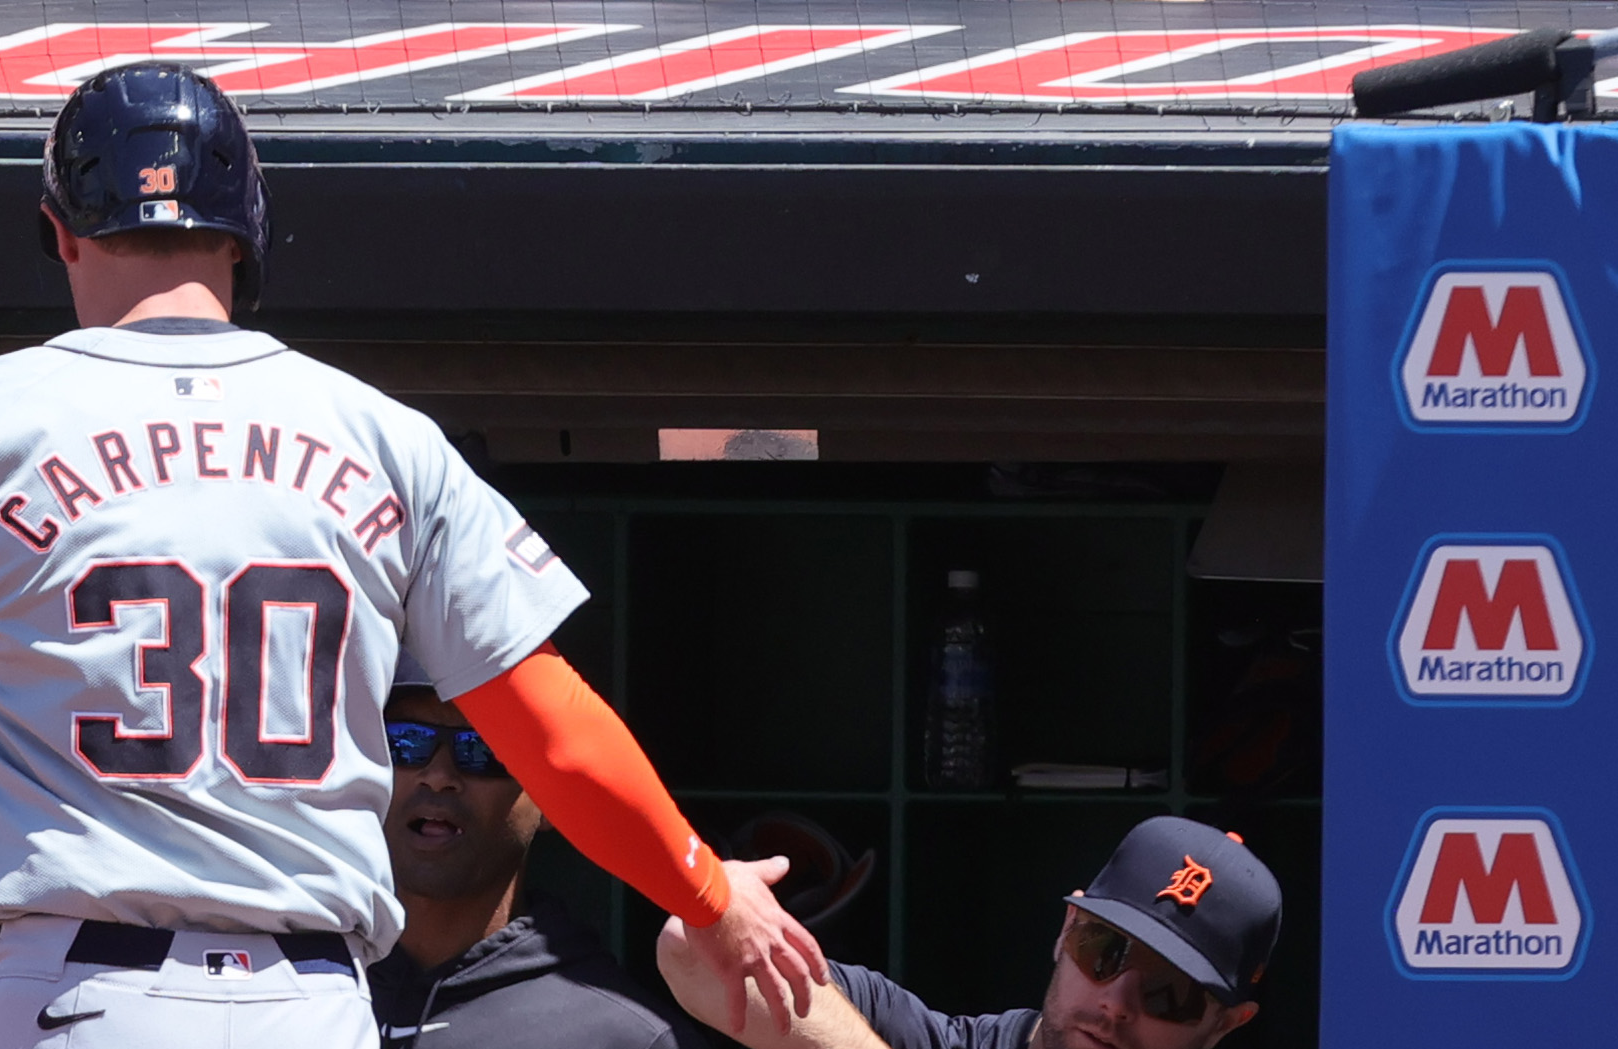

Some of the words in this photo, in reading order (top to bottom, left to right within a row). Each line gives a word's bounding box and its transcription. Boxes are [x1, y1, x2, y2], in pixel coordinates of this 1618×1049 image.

[139, 167, 175, 194] 30
[1427, 286, 1561, 377] M
[1421, 382, 1568, 409] Marathon
[1423, 559, 1558, 651] M
[65, 557, 354, 787] 30
[1418, 656, 1565, 682] Marathon
[1156, 854, 1213, 905] D
[1420, 832, 1556, 925] M
[1416, 929, 1563, 956] Marathon
